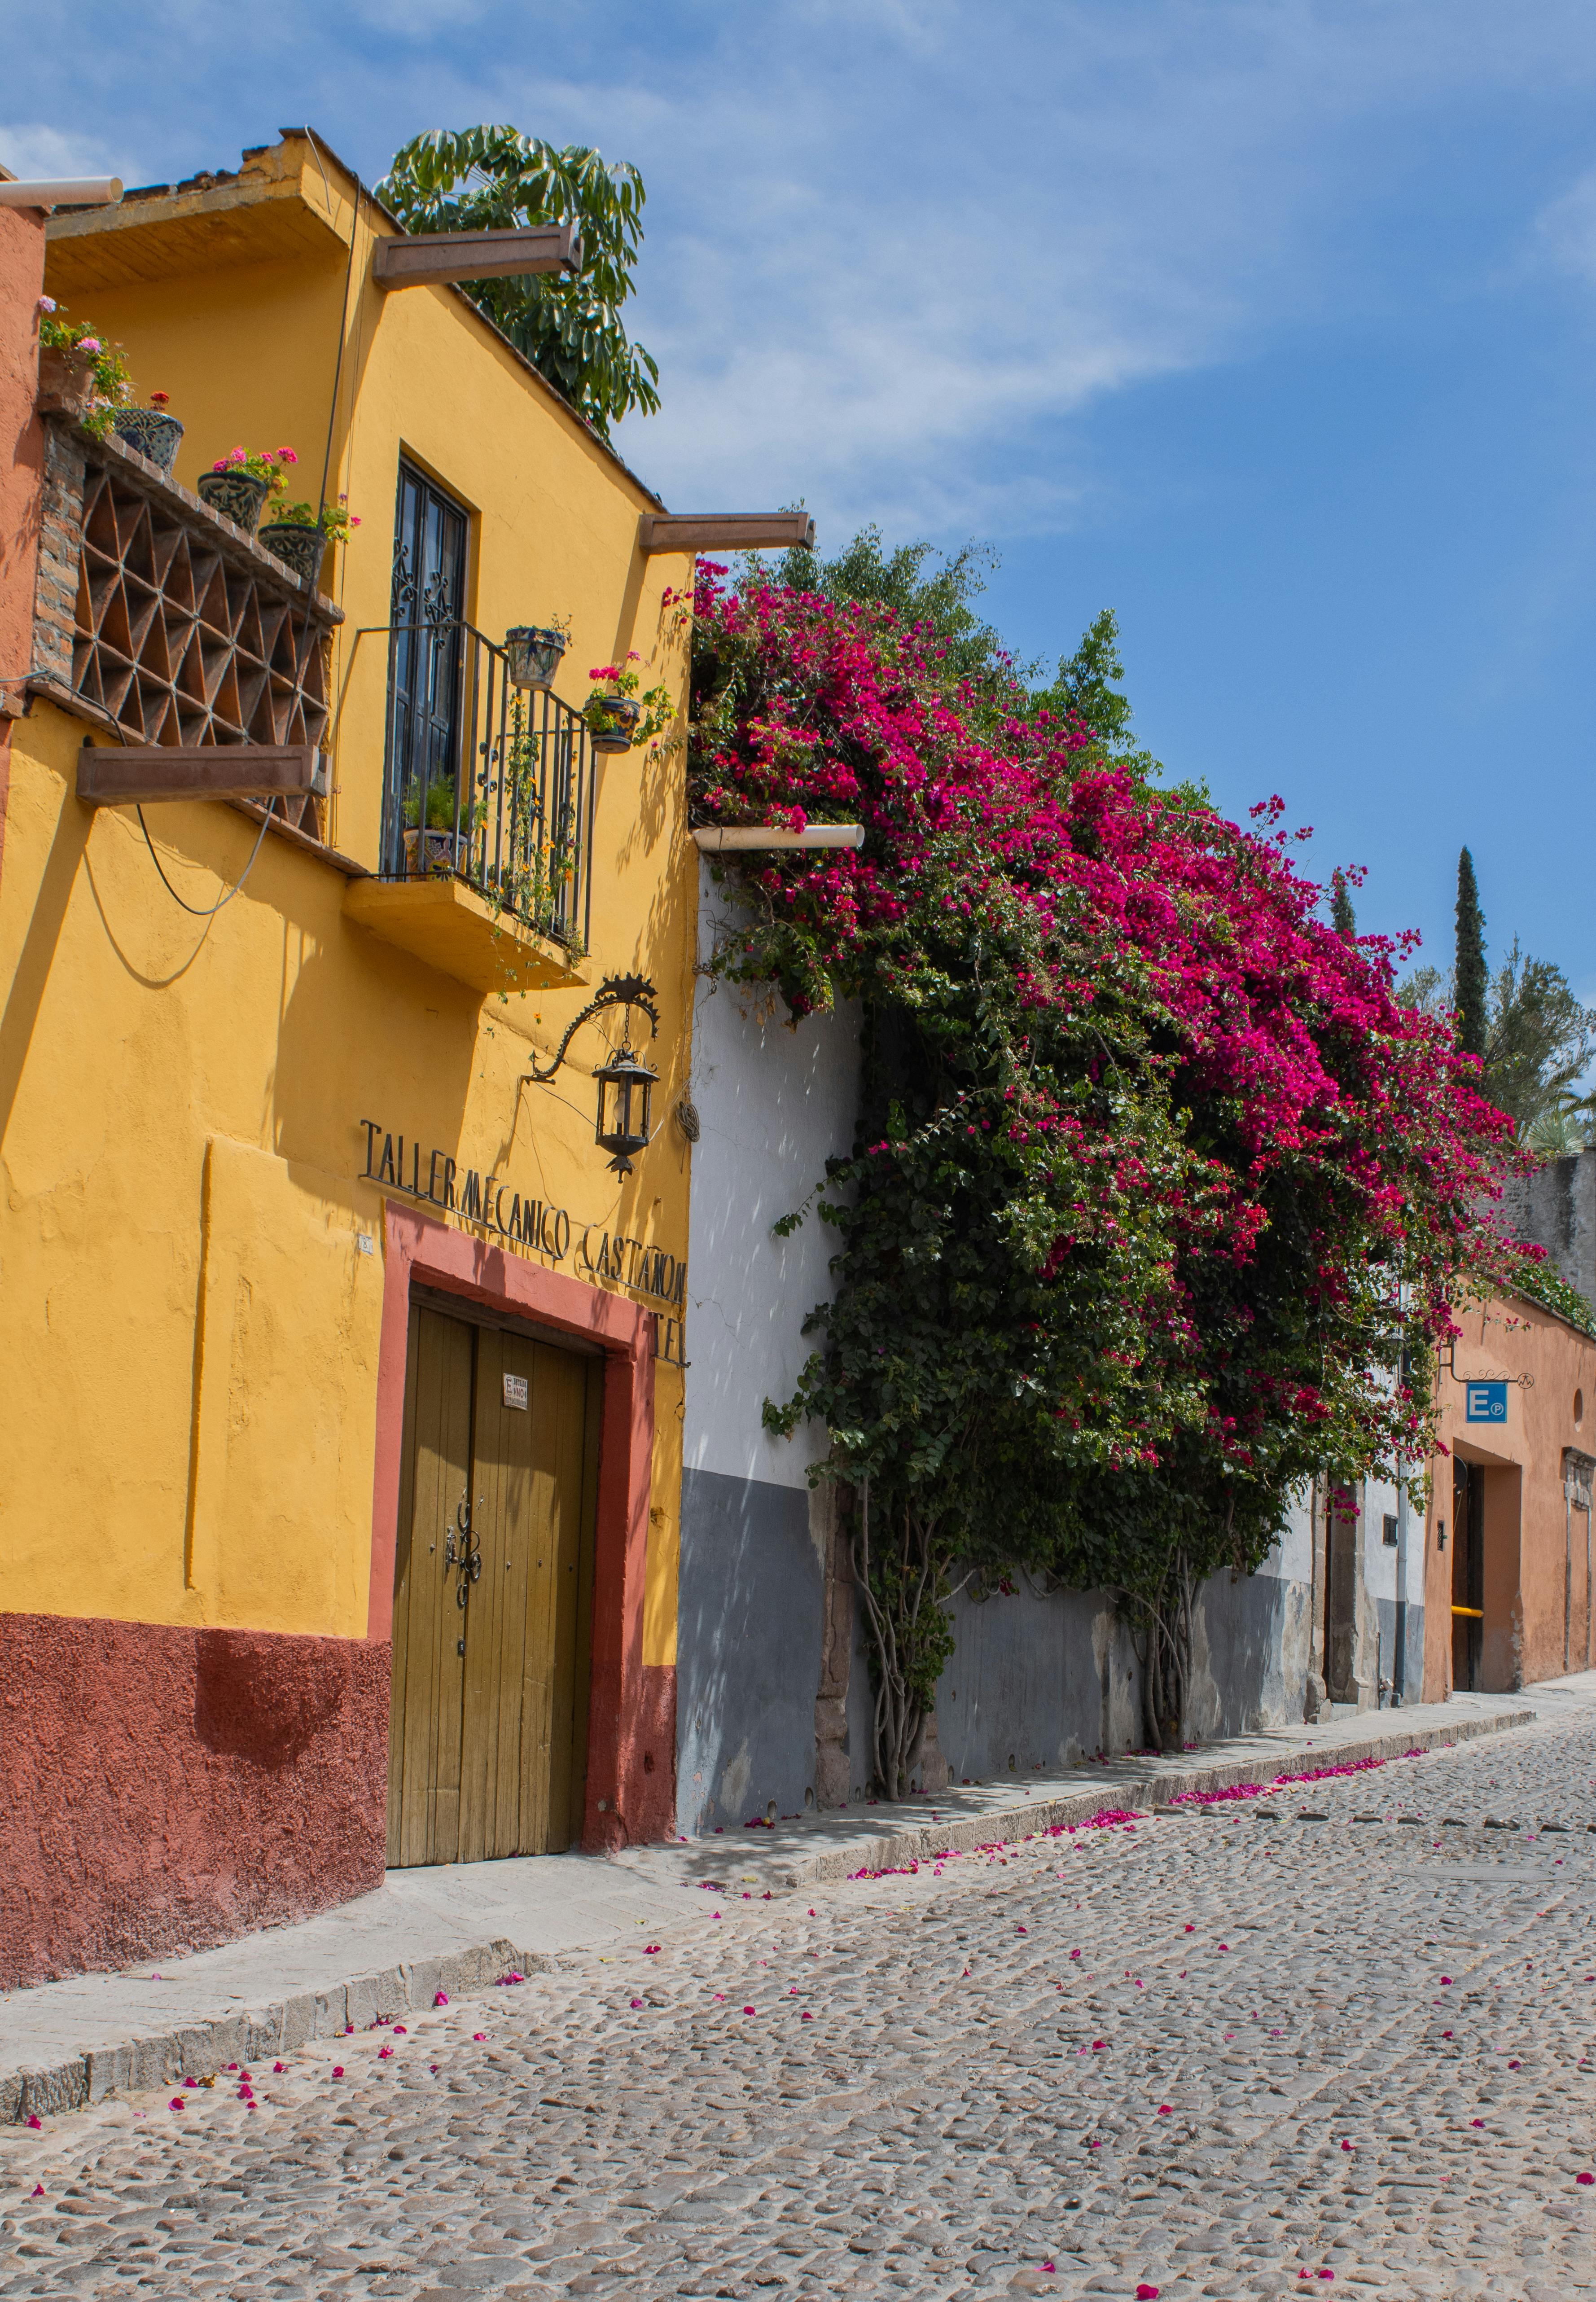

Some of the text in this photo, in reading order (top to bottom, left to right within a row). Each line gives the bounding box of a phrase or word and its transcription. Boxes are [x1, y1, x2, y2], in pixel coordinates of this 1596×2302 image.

[360, 1119, 456, 1209] TALLER
[460, 1169, 570, 1258] MECANICO
[516, 1387, 524, 1399] NO
[1469, 1390, 1489, 1416] E
